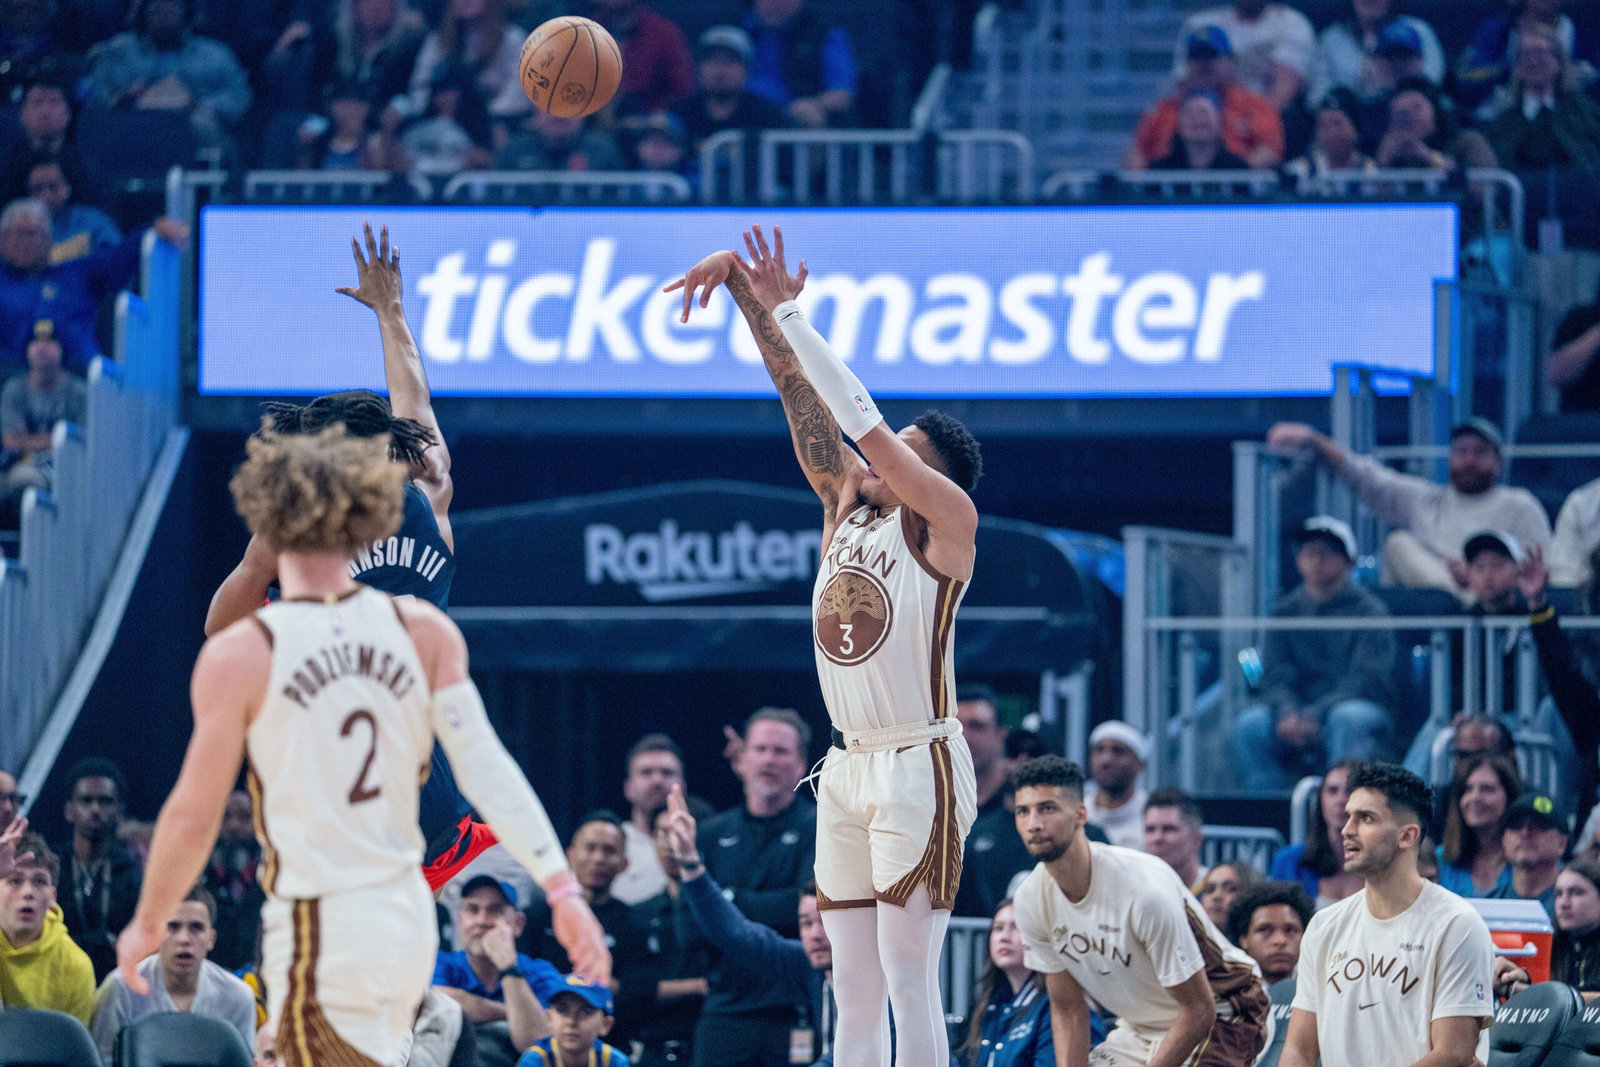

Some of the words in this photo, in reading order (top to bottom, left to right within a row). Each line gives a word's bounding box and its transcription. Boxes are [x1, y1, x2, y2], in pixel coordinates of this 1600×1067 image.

[415, 544, 447, 582] III
[584, 518, 825, 586] Rakuten
[827, 543, 897, 579] TOWN
[839, 623, 854, 655] 3
[339, 708, 382, 804] 2
[1059, 933, 1131, 968] TOWN
[1327, 953, 1419, 996] TOWN
[1495, 1007, 1550, 1024] WAYMO
